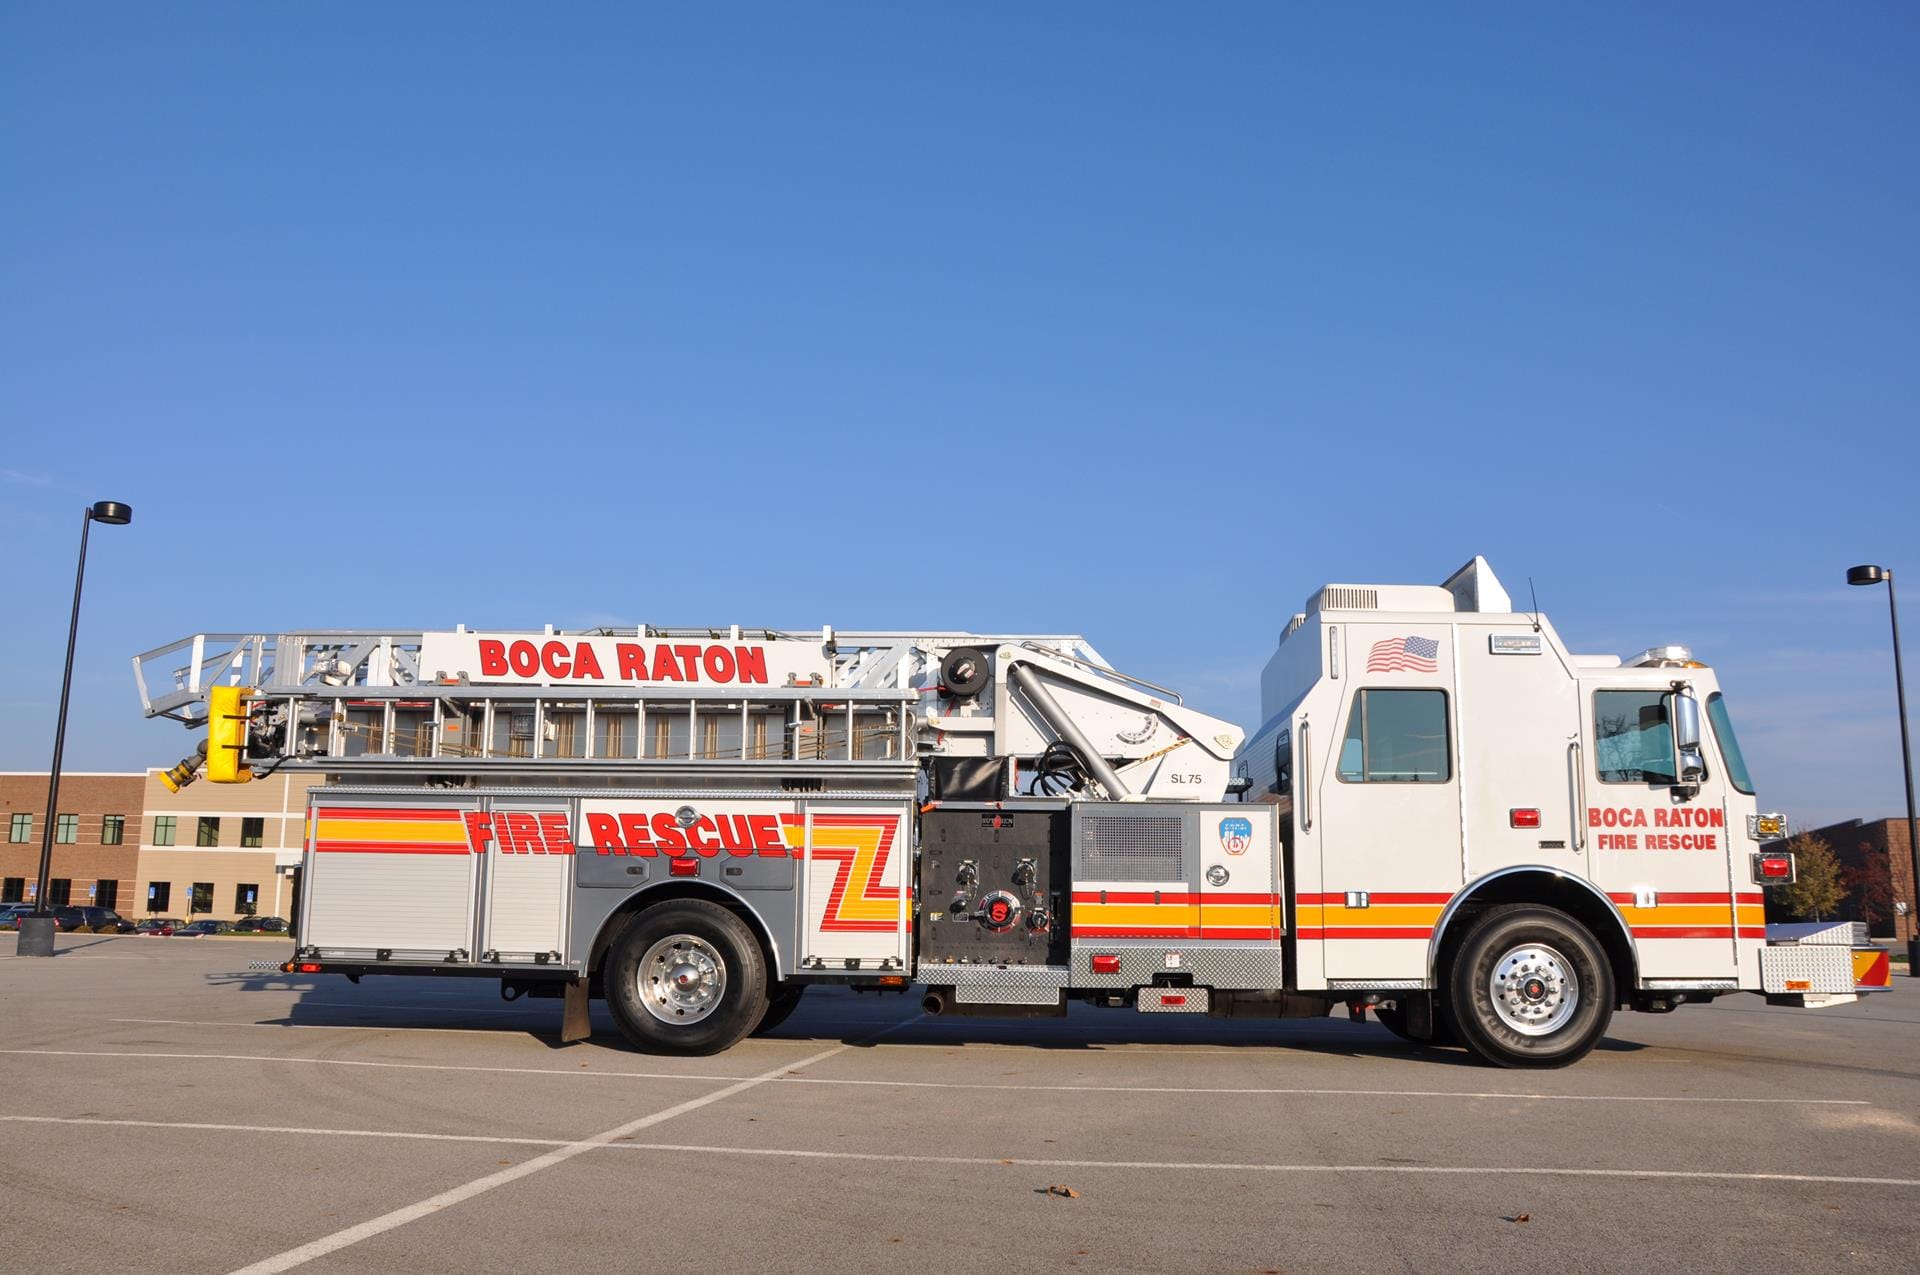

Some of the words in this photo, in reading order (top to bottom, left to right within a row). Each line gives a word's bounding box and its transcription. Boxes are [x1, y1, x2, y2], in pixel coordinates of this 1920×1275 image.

[478, 640, 604, 680] BOCA
[616, 643, 768, 684] RATON
[1171, 774, 1185, 784] SL
[1188, 774, 1202, 784] 75
[1588, 808, 1648, 828] BOCA
[1654, 808, 1724, 828] RATON
[464, 811, 576, 855] FIRE
[586, 812, 794, 858] RESCUE
[1598, 834, 1638, 850] FIRE
[1645, 834, 1717, 850] RESCUE
